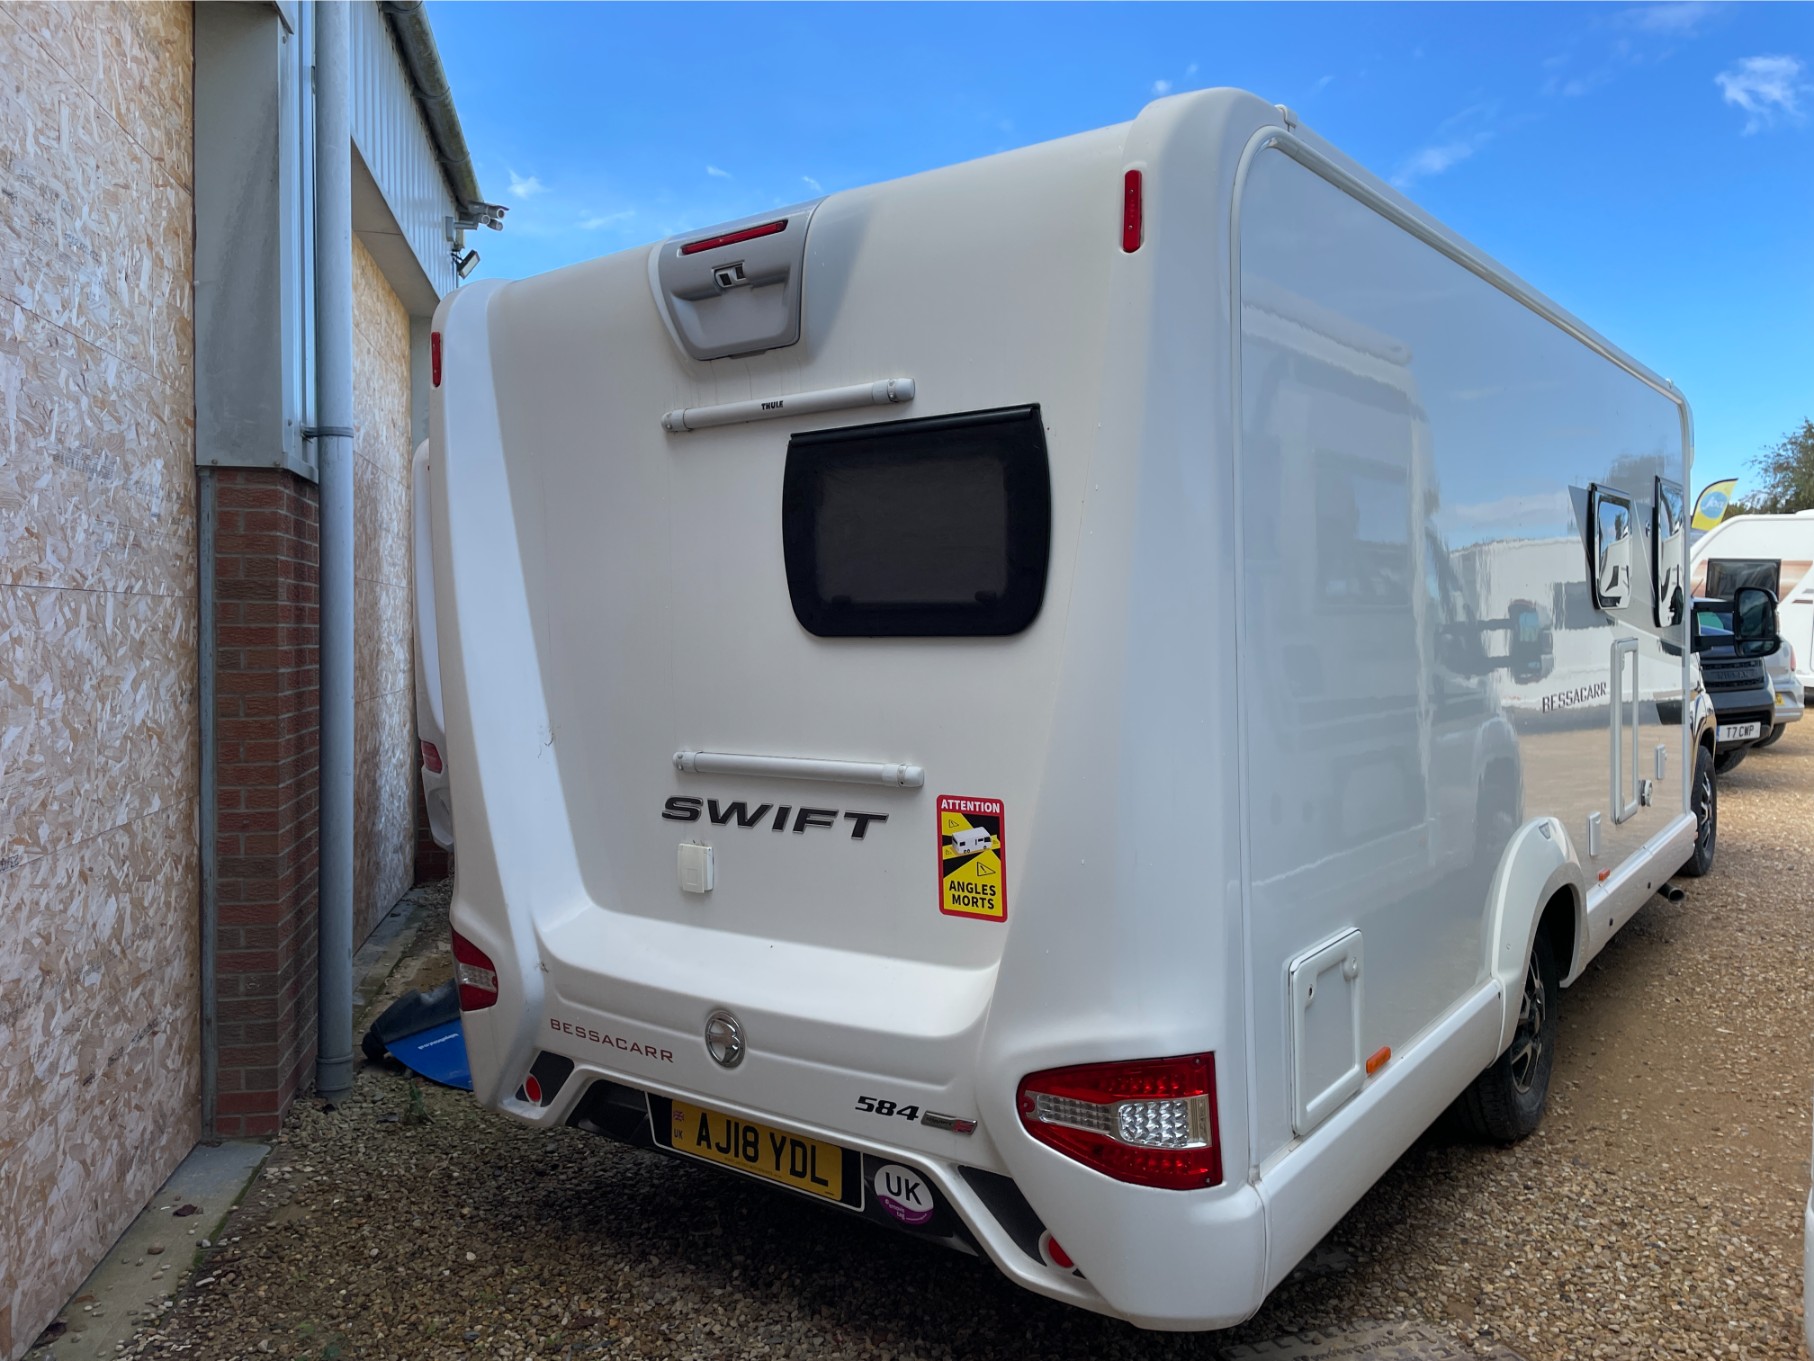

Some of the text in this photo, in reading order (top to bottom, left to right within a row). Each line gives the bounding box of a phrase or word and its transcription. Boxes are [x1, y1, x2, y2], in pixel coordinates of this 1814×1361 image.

[761, 400, 783, 410] THULE
[1542, 681, 1607, 714] BESSACARR
[1727, 726, 1737, 738] T7
[941, 799, 1000, 813] ATTENTION
[662, 795, 889, 840] SWIFT
[949, 880, 996, 896] ANGLES
[952, 893, 995, 910] MORTS
[551, 1019, 674, 1063] BESSACARR
[855, 1095, 919, 1121] 584
[674, 1127, 683, 1140] UK
[696, 1112, 759, 1163] AJ18
[769, 1131, 829, 1187] YDL
[885, 1172, 922, 1205] UK
